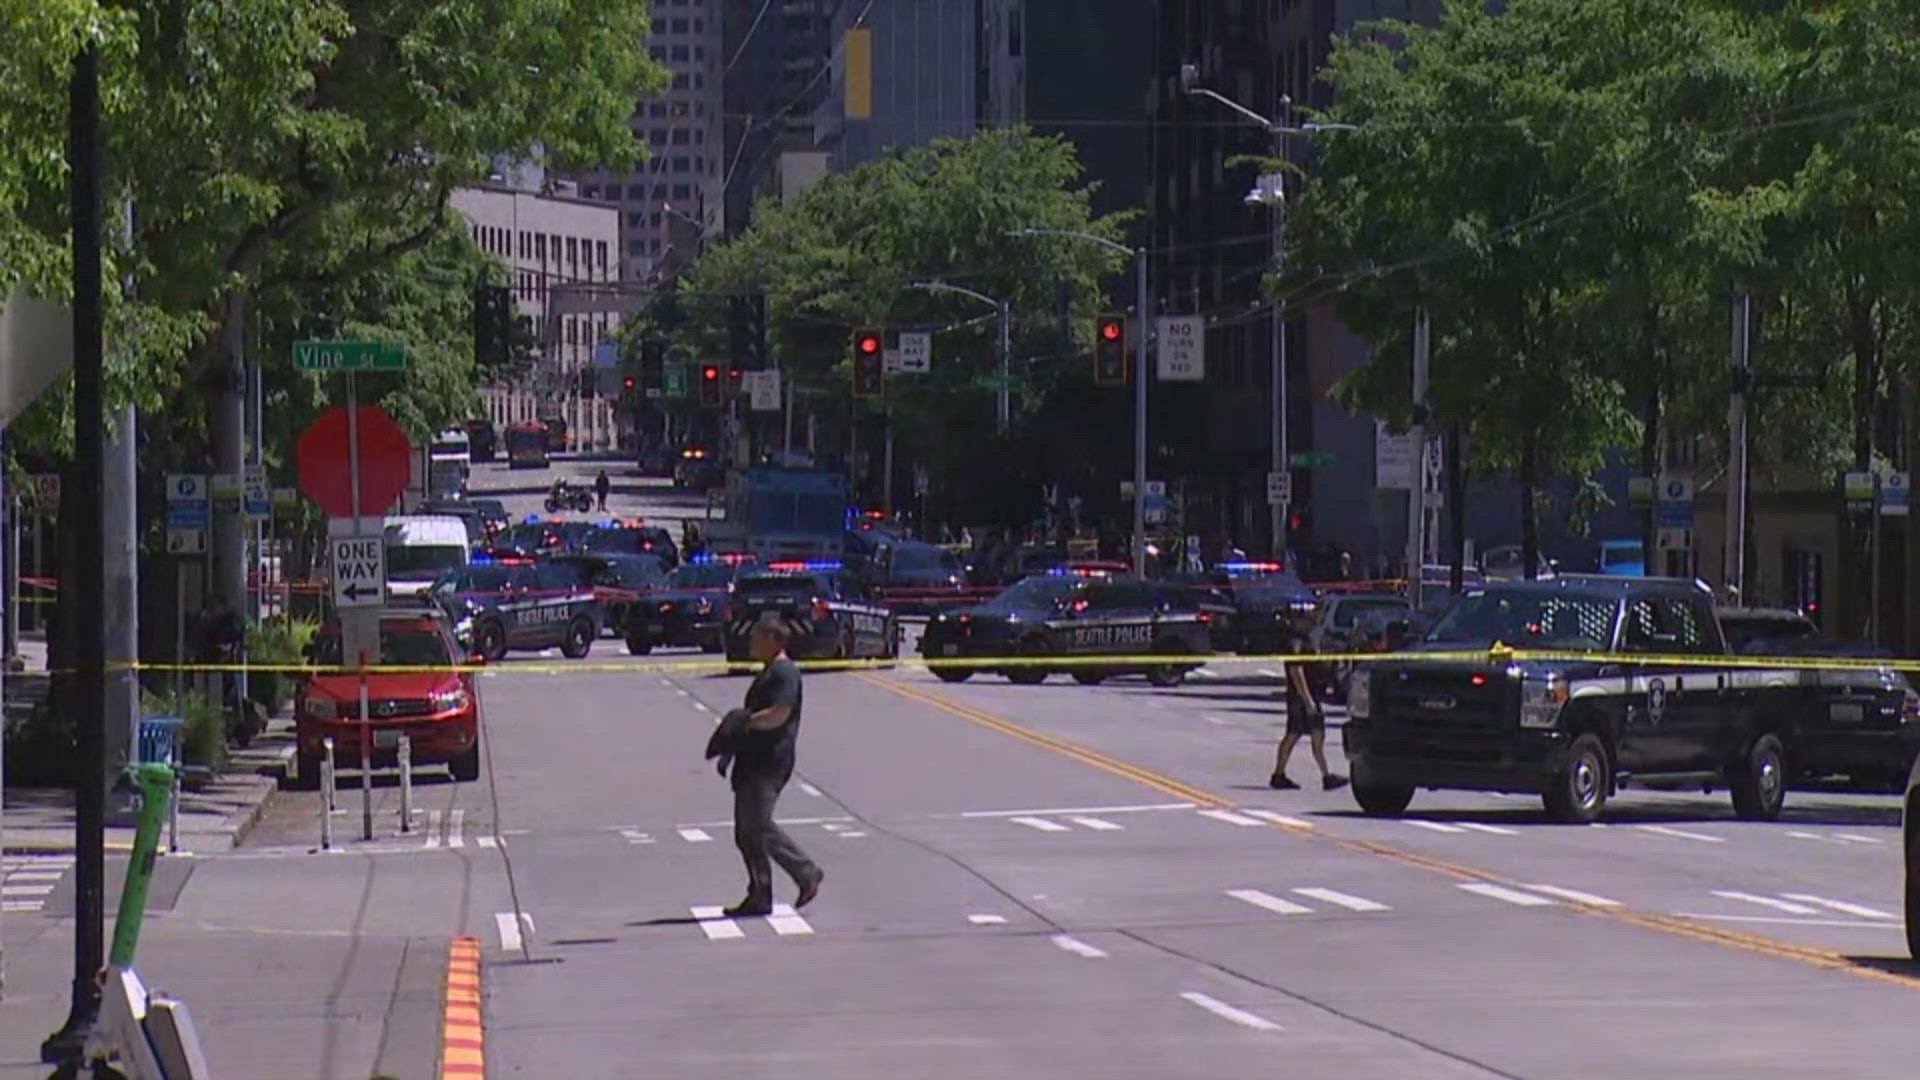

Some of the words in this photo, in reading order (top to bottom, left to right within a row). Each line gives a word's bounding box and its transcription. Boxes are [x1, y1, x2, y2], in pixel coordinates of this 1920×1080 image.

[1169, 323, 1192, 336] NO
[300, 345, 344, 368] Vine
[338, 542, 377, 560] ONE
[337, 561, 379, 579] WAY
[1075, 626, 1113, 643] SEATTLE
[1115, 624, 1153, 643] POLICE
